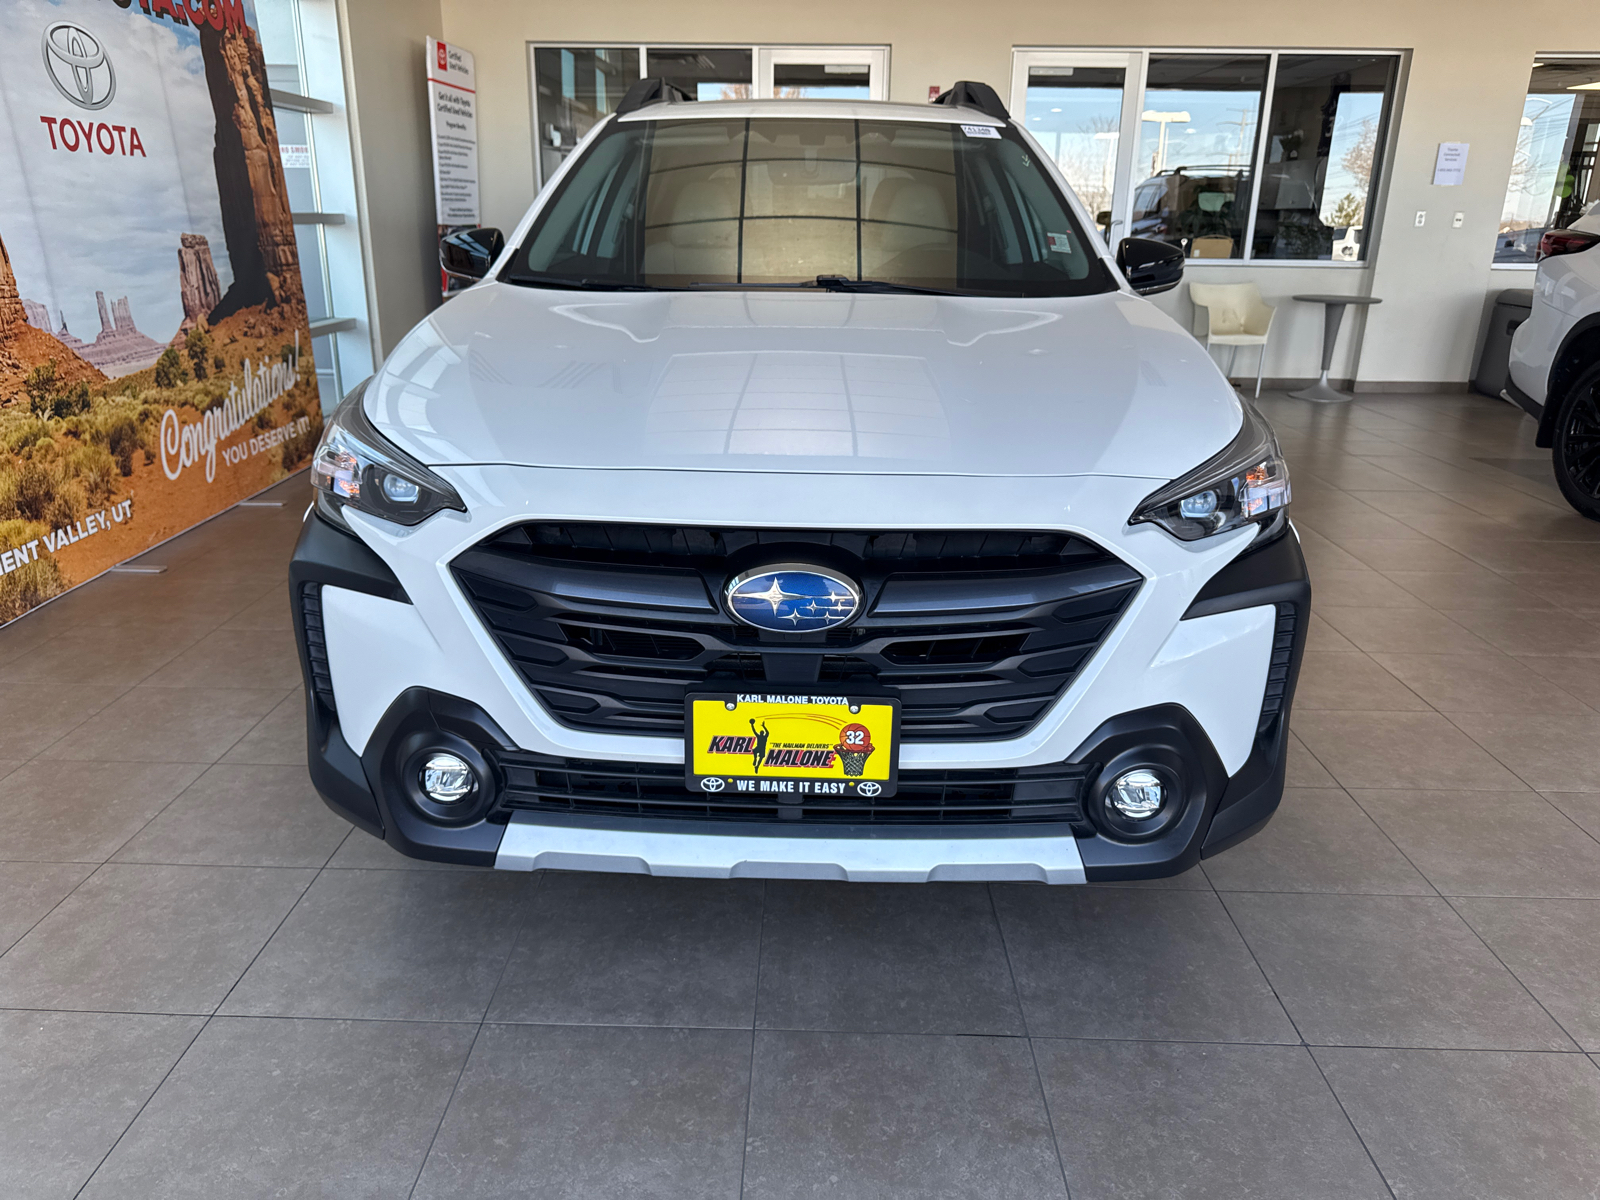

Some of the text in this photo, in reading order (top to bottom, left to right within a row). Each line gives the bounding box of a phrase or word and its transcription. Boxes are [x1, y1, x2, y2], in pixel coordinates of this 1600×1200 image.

[40, 115, 147, 158] TOYOTA
[160, 329, 301, 484] Congratulations!
[221, 415, 311, 467] YOU DESERVE IT!
[0, 499, 132, 576] ENT VALLEY, UT
[736, 694, 849, 705] KARL MALONE TOYOTA
[707, 735, 757, 755] KARL
[846, 730, 864, 745] 32
[763, 748, 837, 769] MALONE
[736, 780, 845, 794] WE MAKE IT EASY
